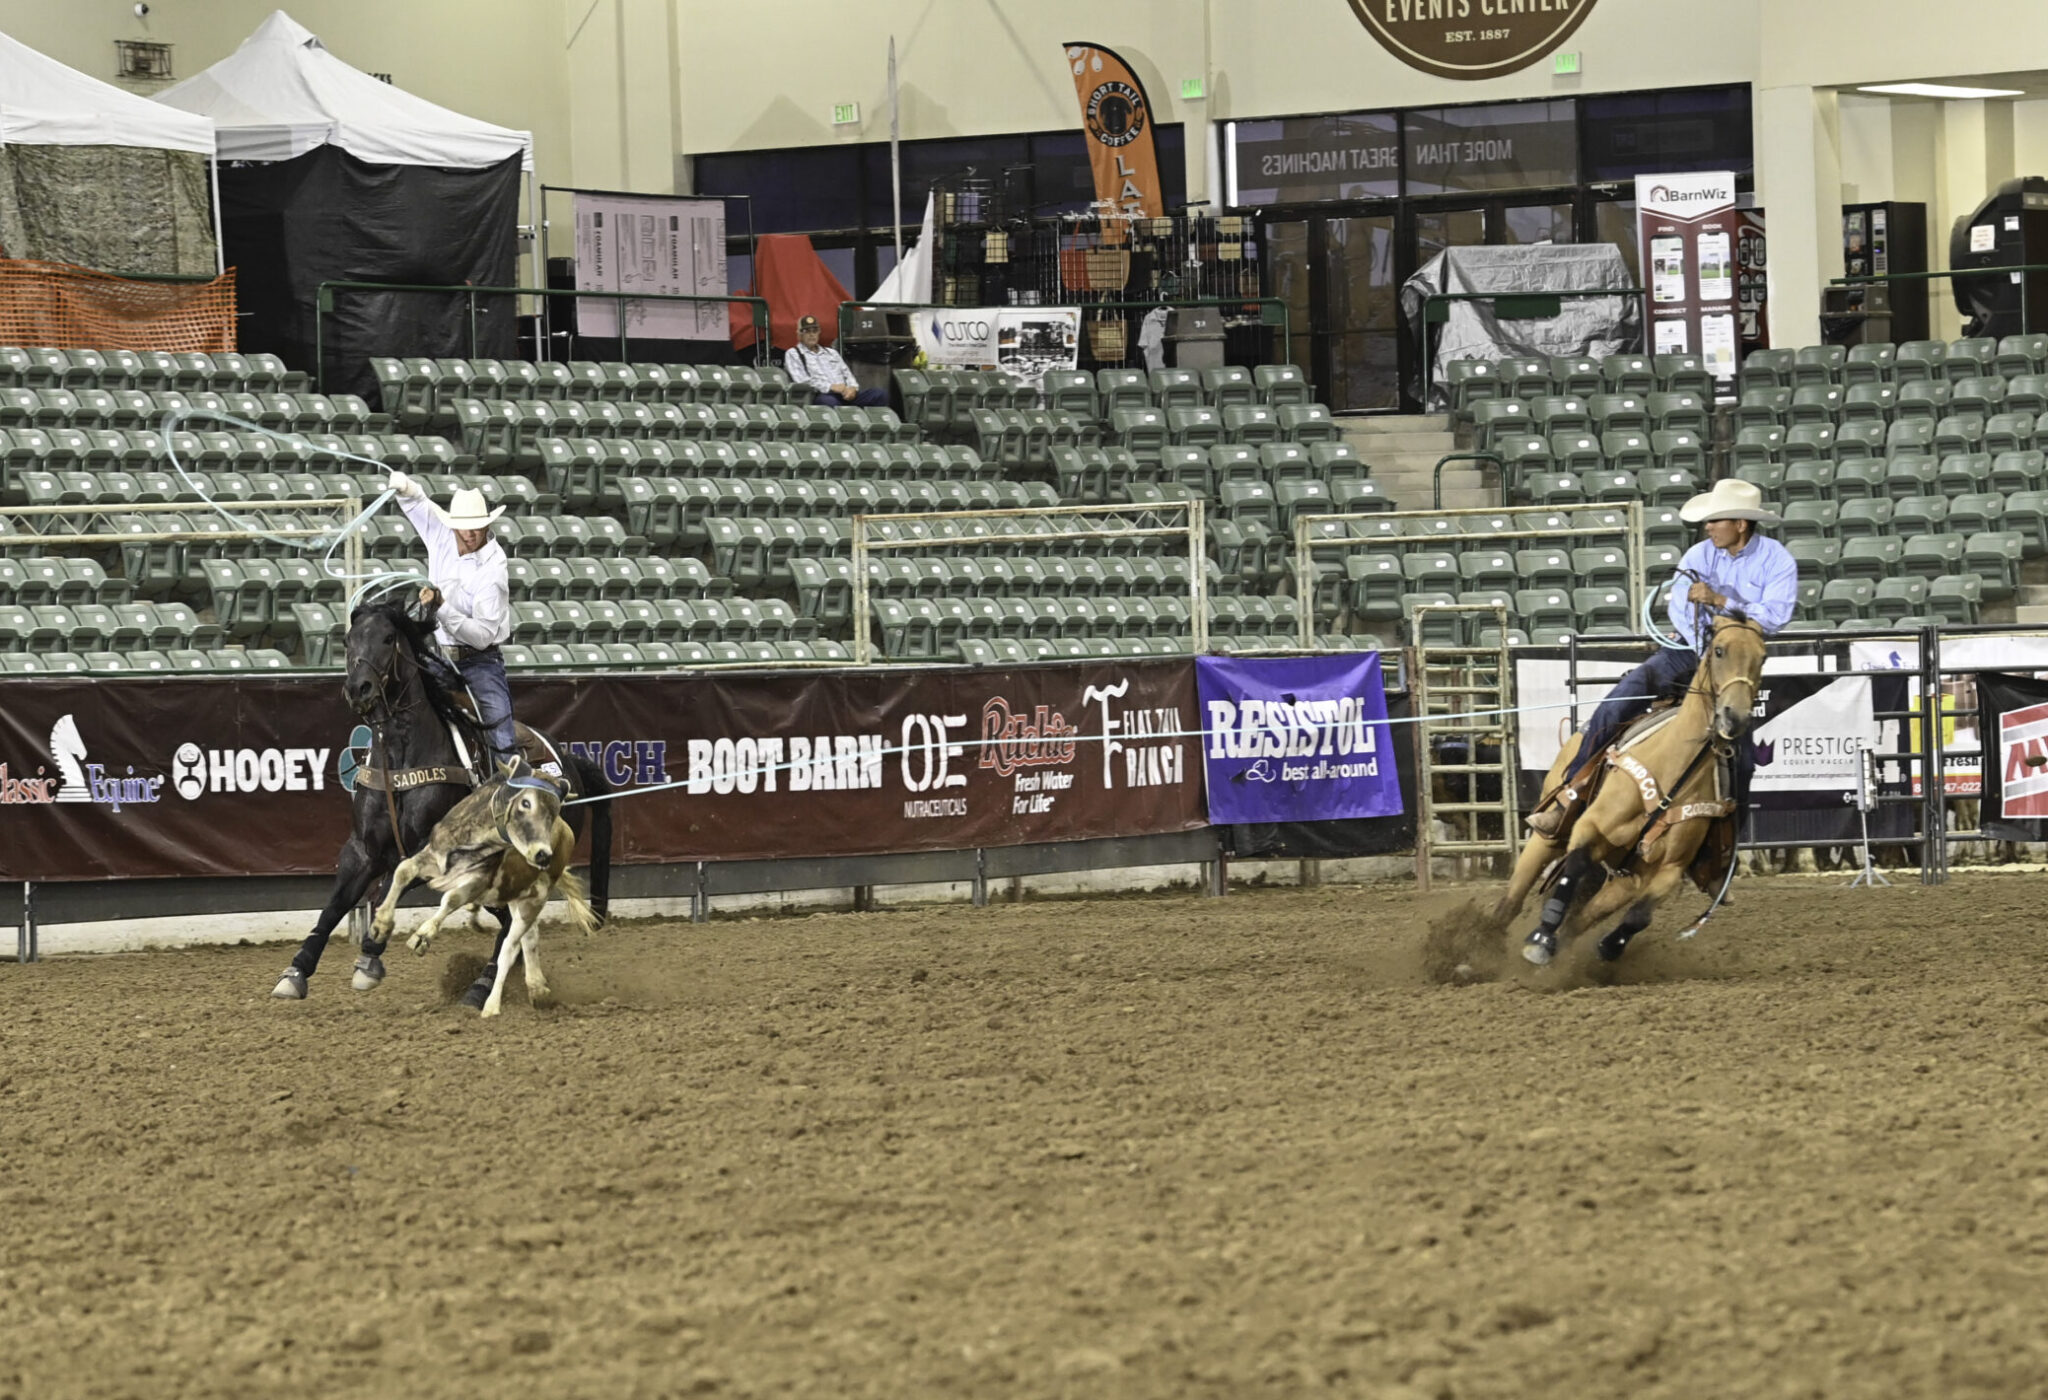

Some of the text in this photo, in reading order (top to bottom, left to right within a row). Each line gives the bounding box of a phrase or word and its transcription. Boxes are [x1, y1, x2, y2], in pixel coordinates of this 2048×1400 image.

[1445, 28, 1510, 42] EST. 1887
[1118, 83, 1141, 106] TAIL
[1100, 127, 1140, 147] COFFEE
[1670, 189, 1727, 201] BarnWiz
[943, 321, 989, 341] CUTCO
[979, 696, 1075, 776] Ritchie
[1208, 697, 1376, 759] RESISTOL
[209, 748, 330, 792] HOOEY
[687, 735, 882, 794] BOOT BARN
[1282, 757, 1378, 781] best all-around
[0, 762, 161, 813] lassic Equine
[393, 767, 447, 788] SADDLES
[1015, 771, 1074, 792] Fresh Water
[904, 799, 967, 818] NUTRACEUTICALS
[1012, 796, 1029, 814] For
